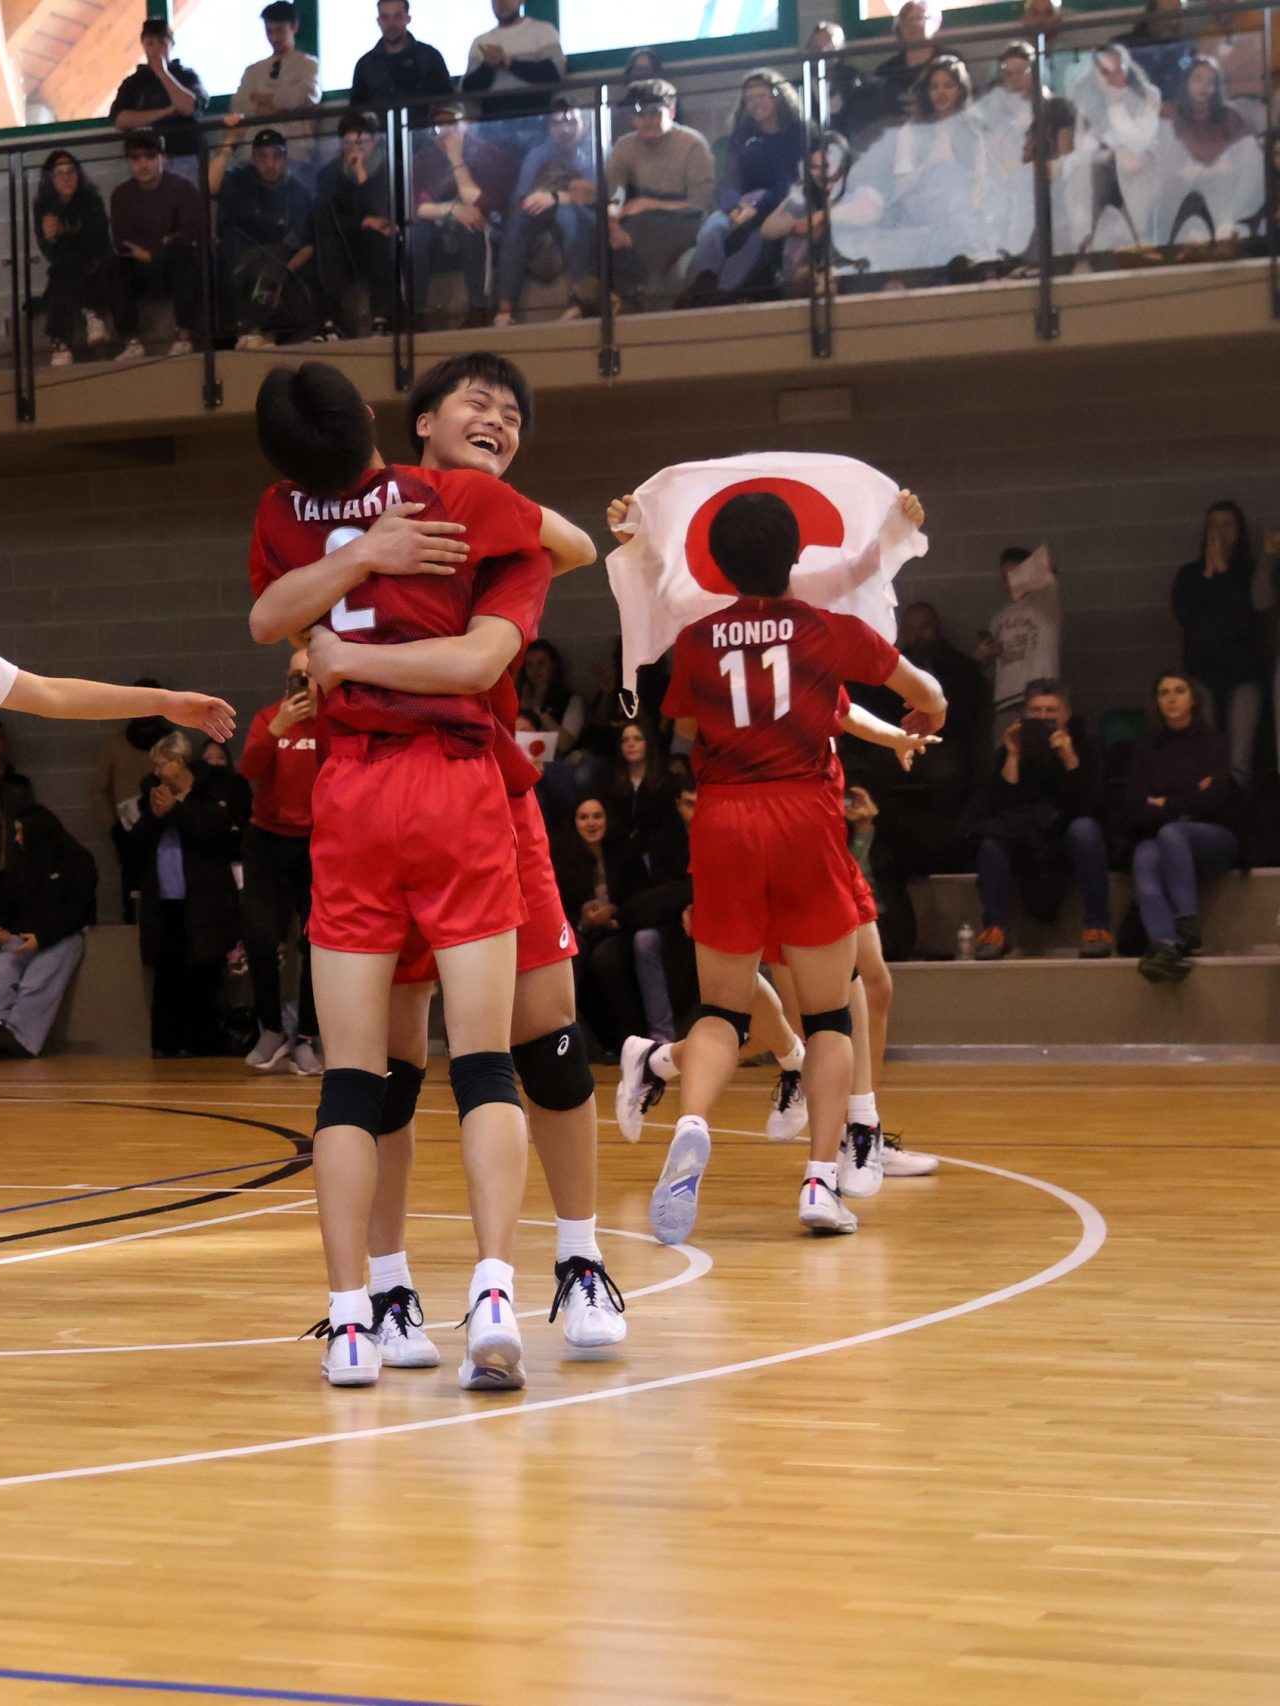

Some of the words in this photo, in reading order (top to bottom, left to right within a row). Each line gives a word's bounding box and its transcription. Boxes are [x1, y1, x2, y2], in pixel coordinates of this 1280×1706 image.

[290, 480, 403, 521] TANAKA
[712, 618, 794, 648] KONDO
[719, 643, 791, 728] 11
